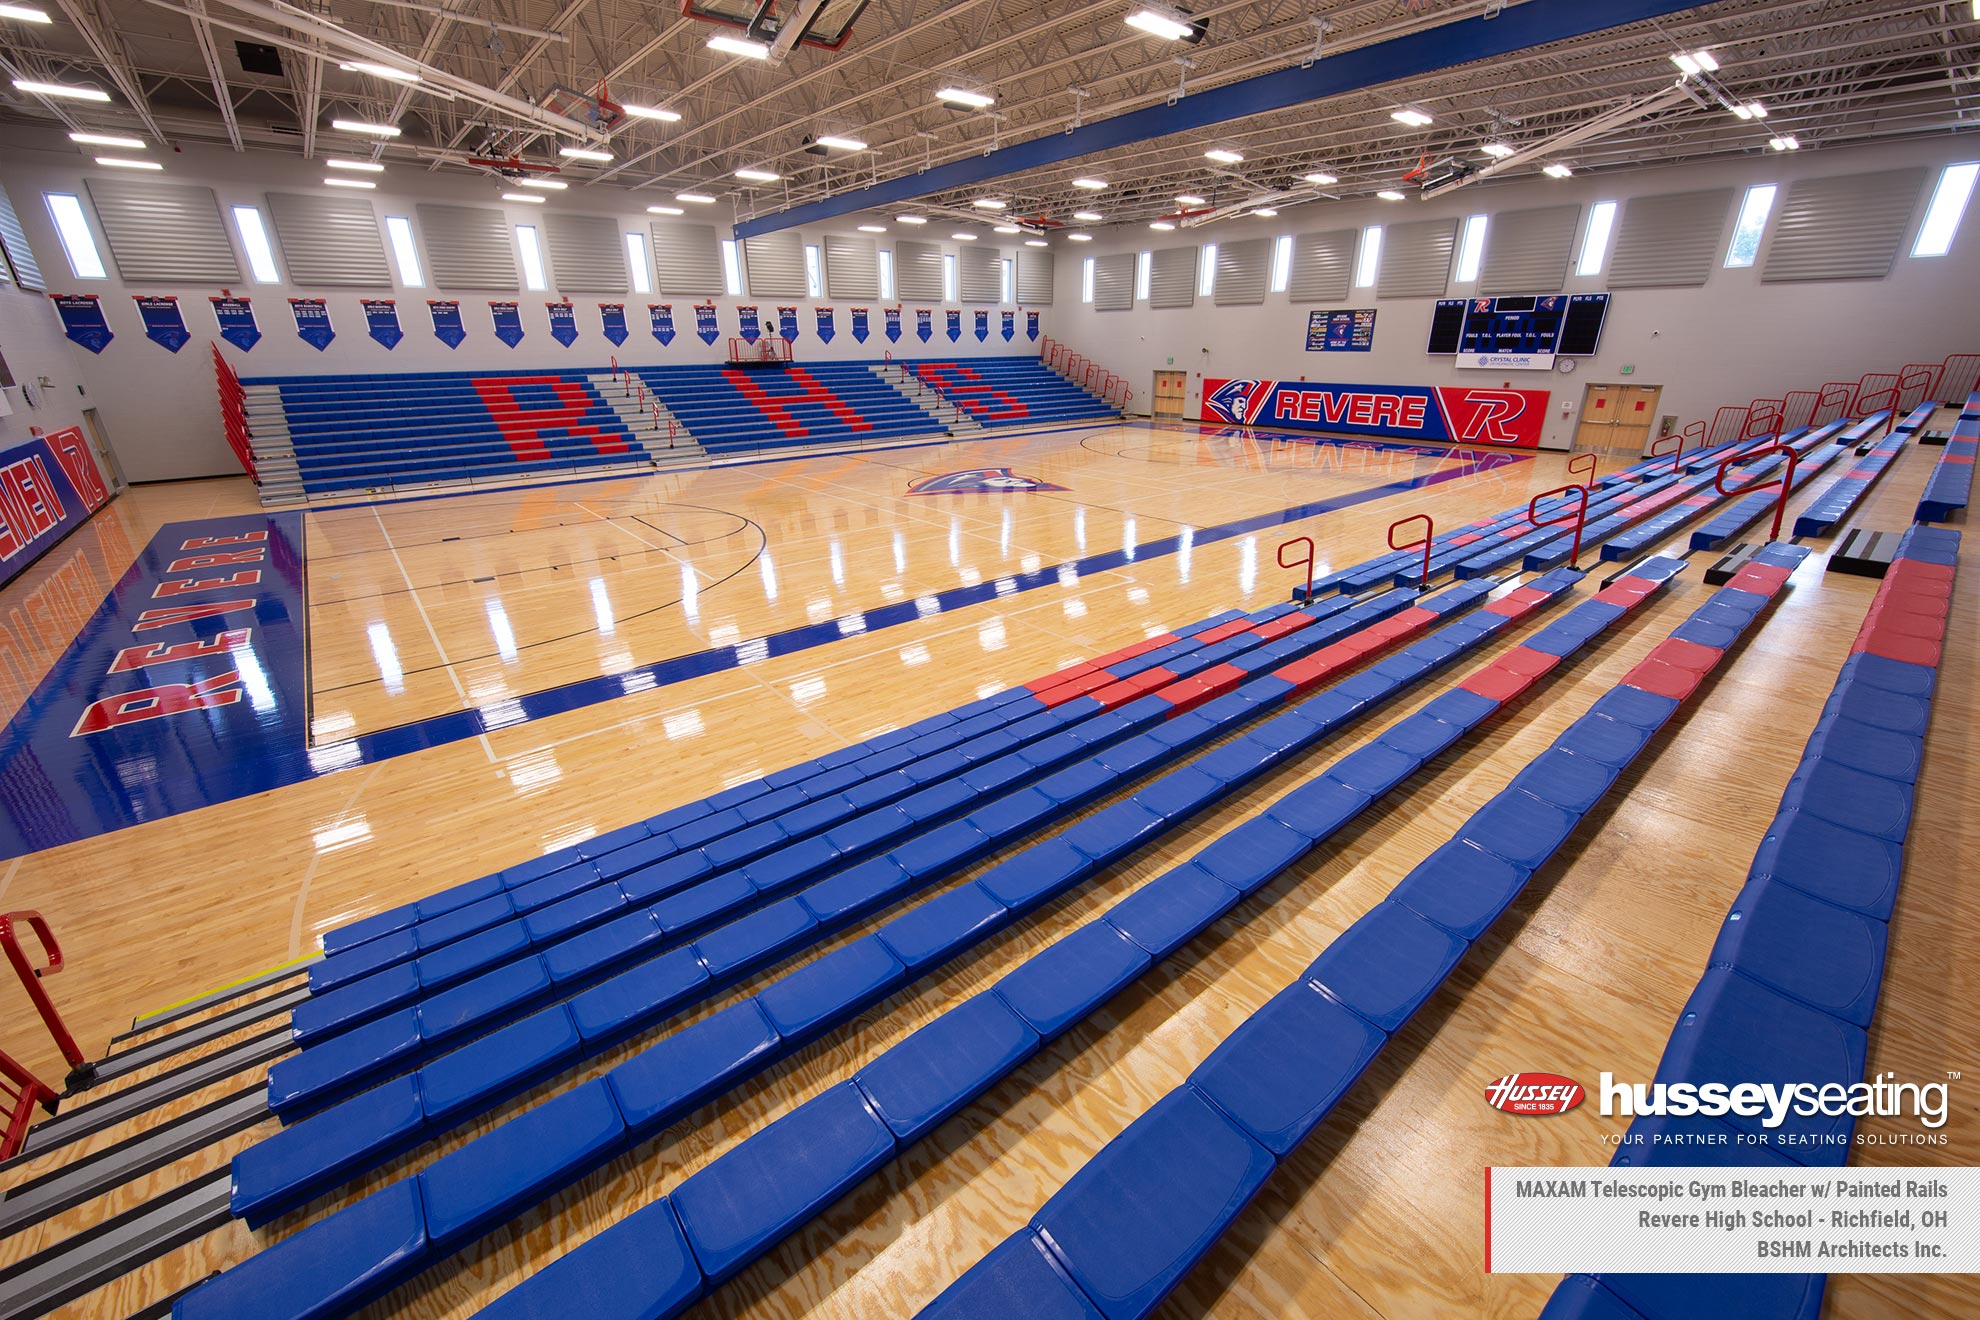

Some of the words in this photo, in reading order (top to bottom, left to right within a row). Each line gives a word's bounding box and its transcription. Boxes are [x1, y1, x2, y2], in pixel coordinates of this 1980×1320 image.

[1274, 390, 1428, 429] REVERE
[1462, 390, 1526, 443] R
[69, 530, 269, 738] REVERE
